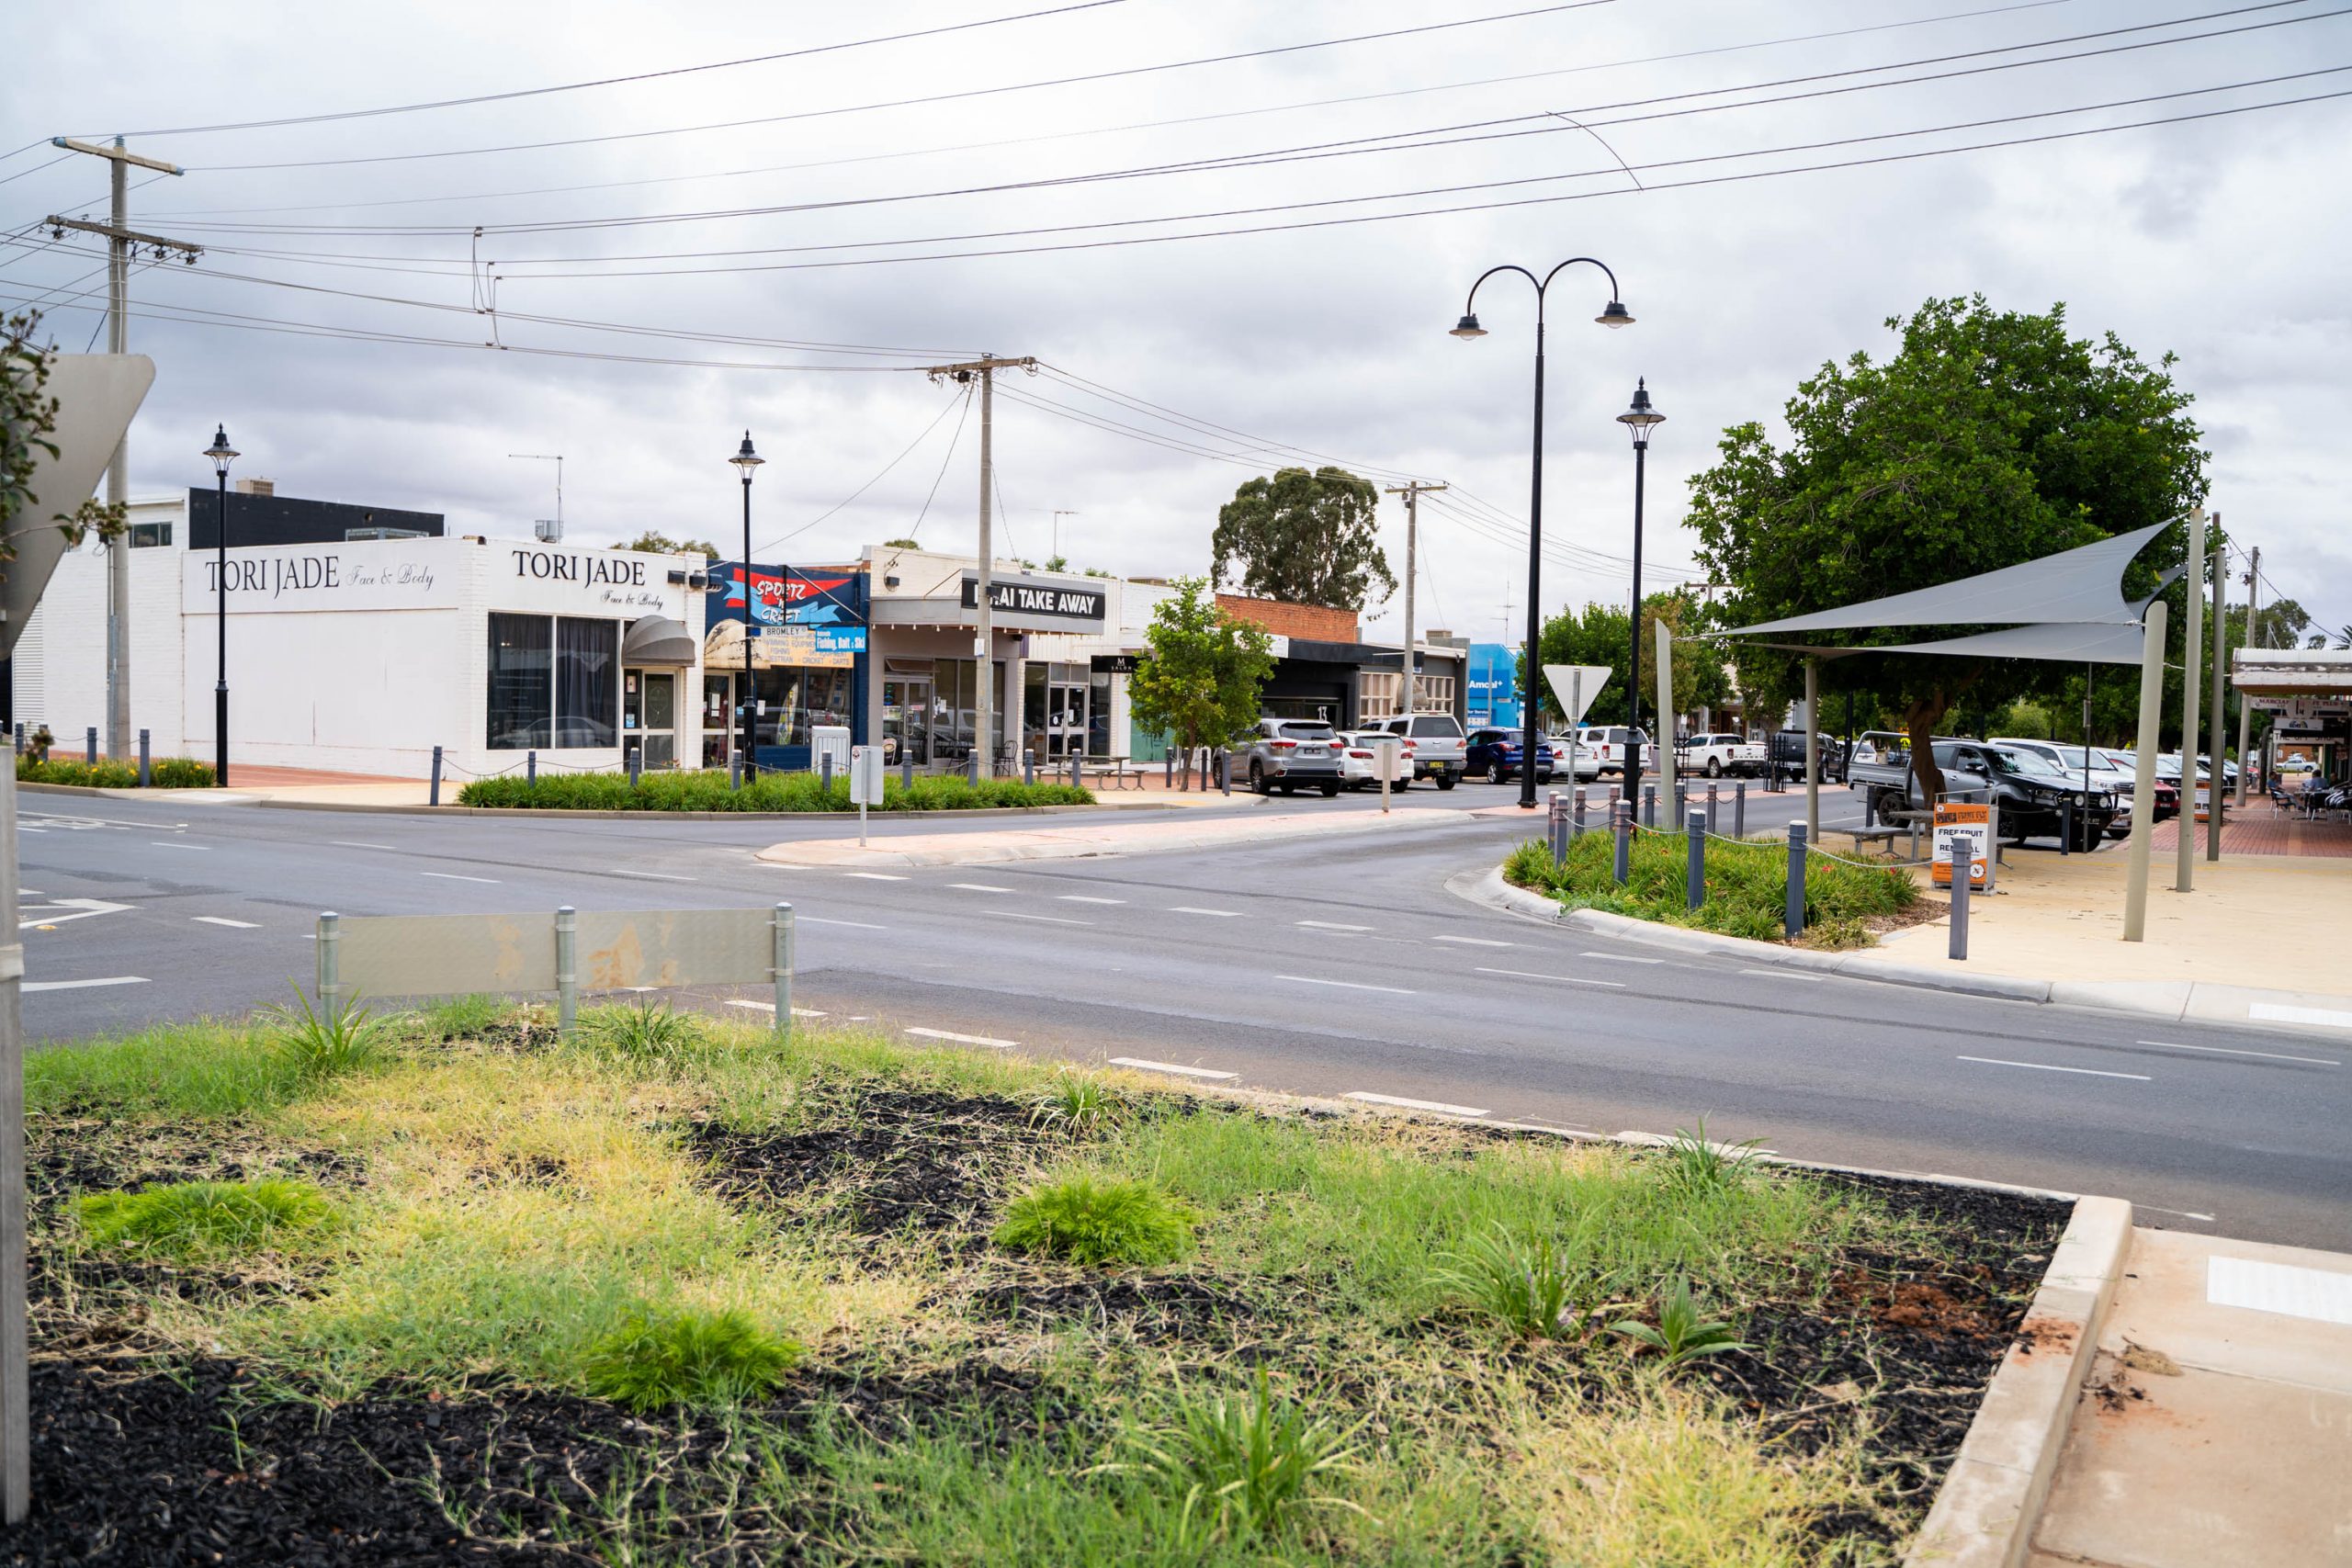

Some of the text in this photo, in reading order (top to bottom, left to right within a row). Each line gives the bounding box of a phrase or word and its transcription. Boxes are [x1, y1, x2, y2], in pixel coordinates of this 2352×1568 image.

[205, 556, 435, 599] TORI JADE Face & Body
[512, 550, 646, 589] TORI JADE
[600, 590, 664, 610] Face & Body
[756, 580, 807, 600] SPORTZ
[1018, 589, 1055, 612] TAKE
[1057, 593, 1096, 615] AWAY
[761, 607, 801, 626] CRAFT
[766, 627, 800, 636] BROMLEY
[1317, 705, 1328, 722] 13
